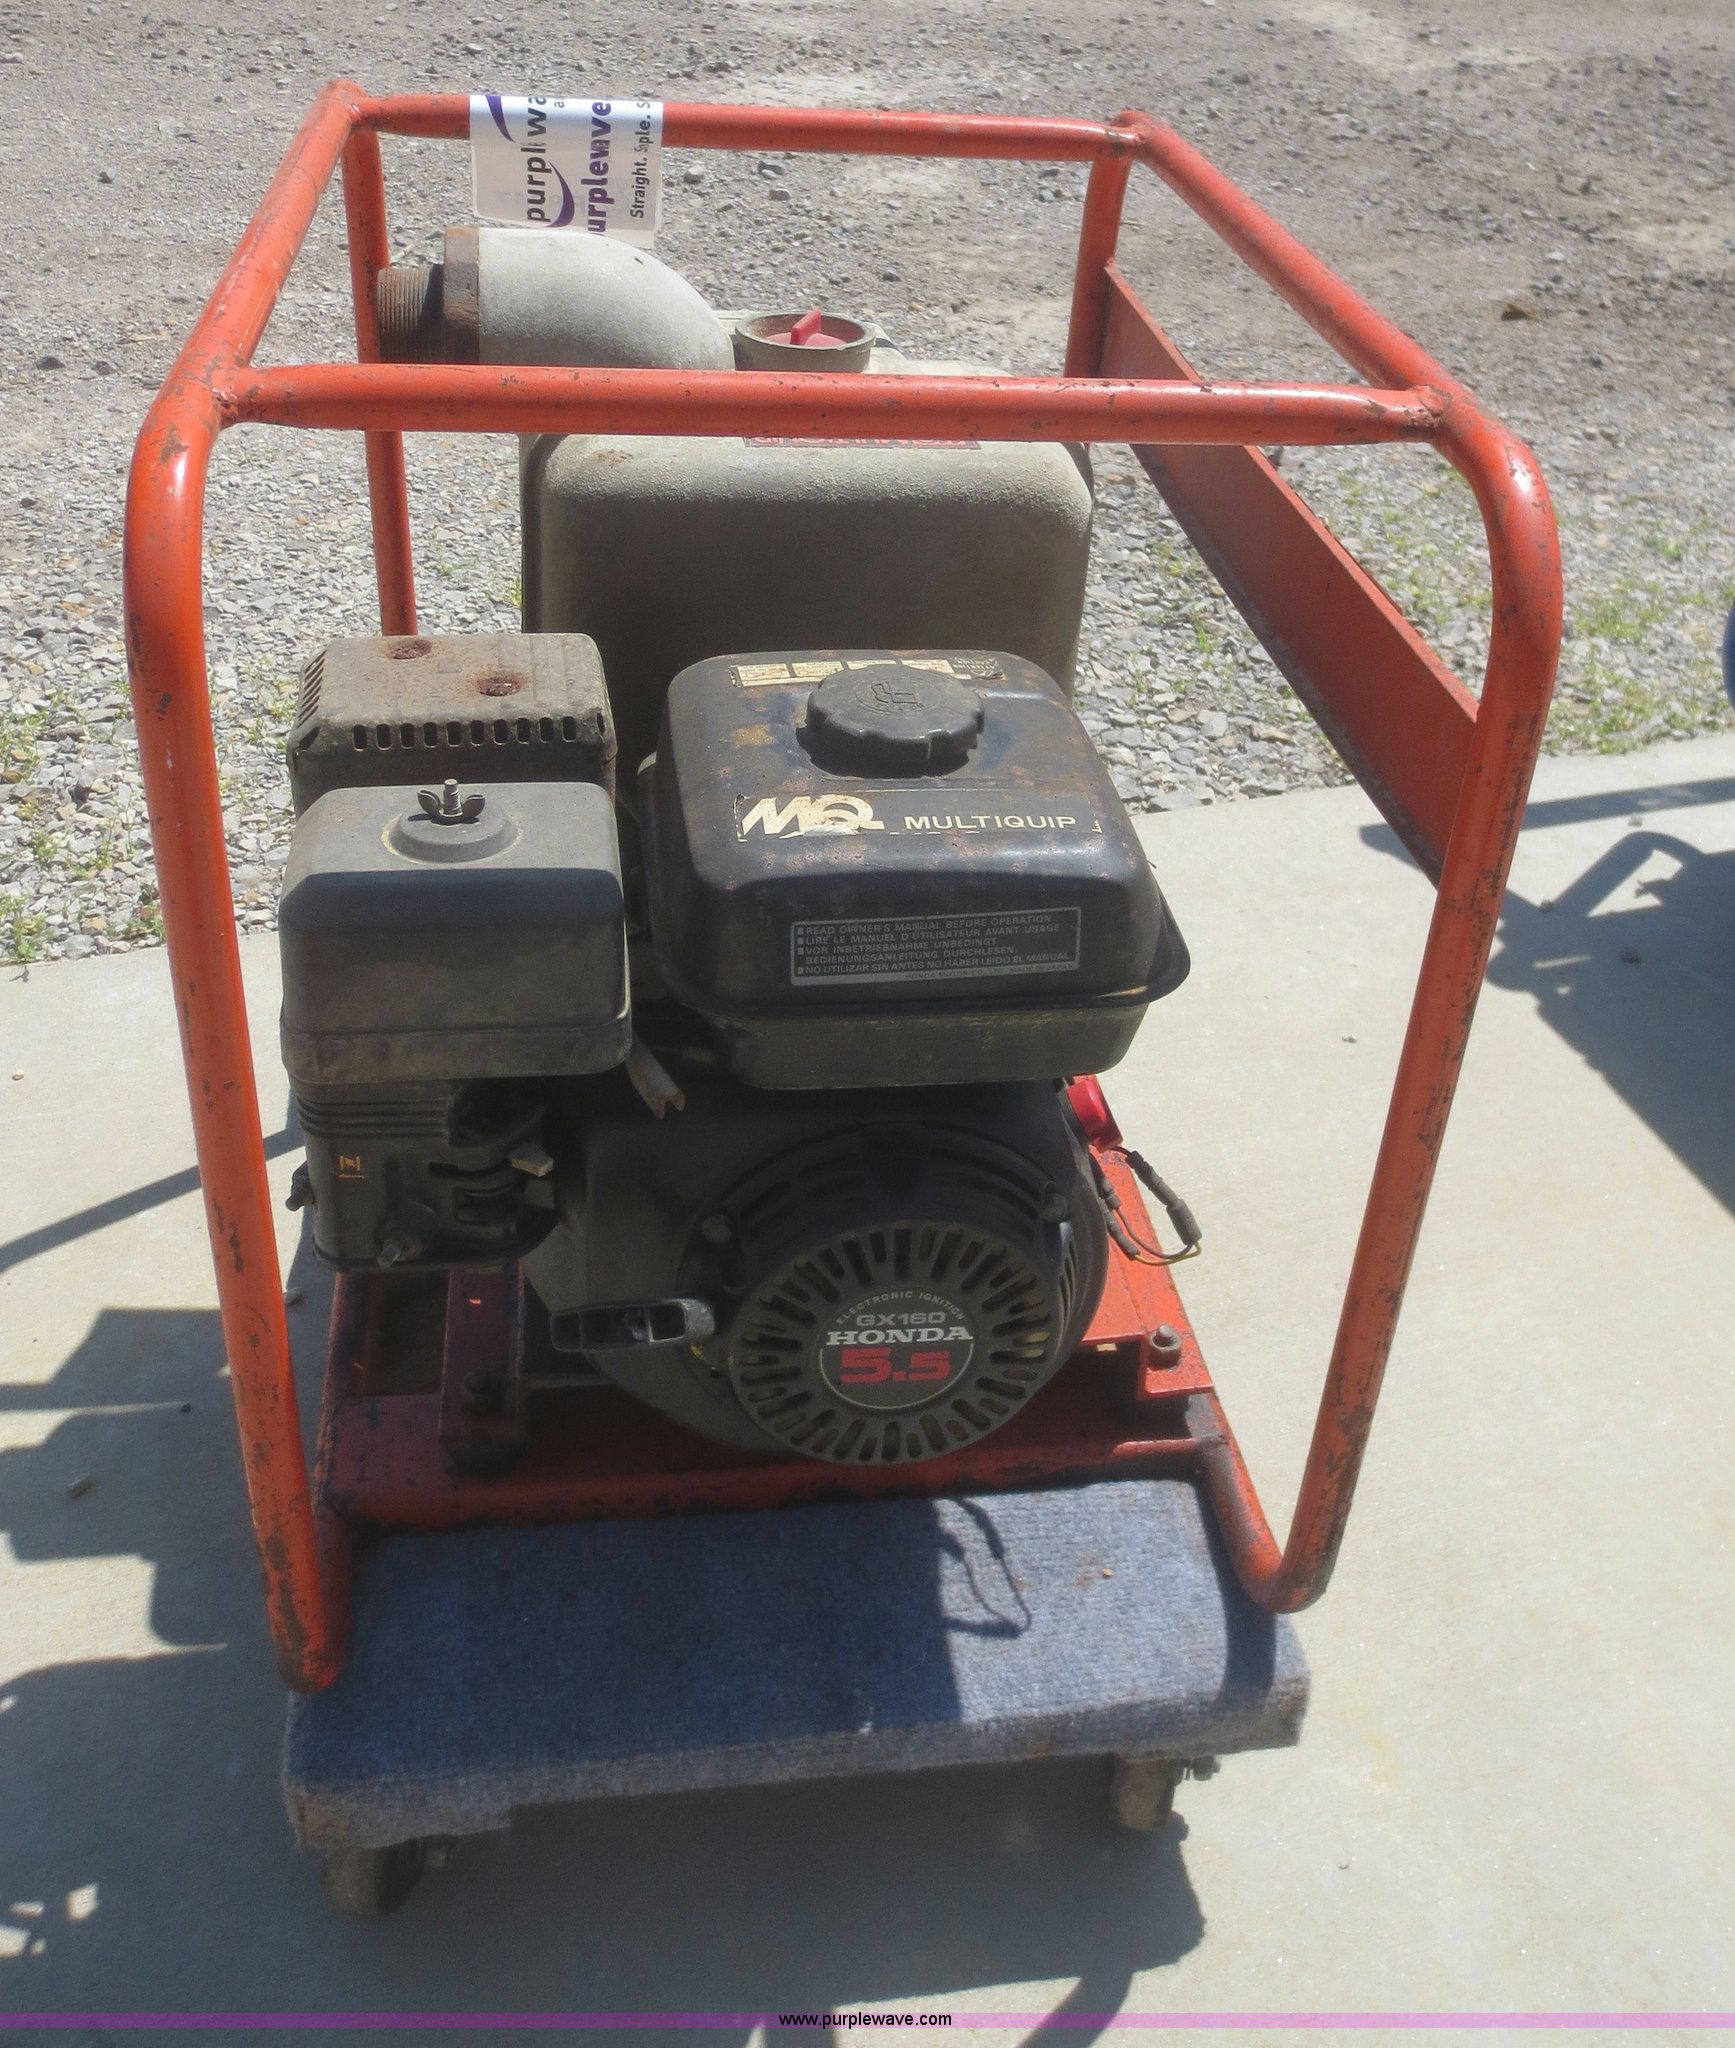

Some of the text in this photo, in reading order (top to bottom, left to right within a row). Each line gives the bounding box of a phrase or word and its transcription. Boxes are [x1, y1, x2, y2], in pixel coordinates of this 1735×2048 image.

[630, 157, 650, 219] Straight.
[742, 794, 1077, 836] MQ MULTIQUIP
[806, 914, 1052, 936] READ OWNER'S MANUAL BEFORE OPERATION
[806, 923, 1060, 945] LIRE LE MANUEL D'UTILISATEUR AVANT USAGE
[806, 937, 998, 955] VOR INBETRIEBNAHME UNBEDINGT
[805, 965, 820, 974] NO
[823, 963, 870, 974] UTILIZAR
[871, 963, 889, 973] SIN
[891, 961, 925, 971] ANTES
[926, 960, 942, 969] NO
[944, 957, 980, 968] HABER
[981, 955, 1011, 966] LEIDO
[1012, 955, 1025, 964] EL
[806, 950, 938, 965] BEDIENUNGSANLEITUNG
[836, 1290, 966, 1324] ELECTRONIC IGNITION
[856, 1311, 947, 1326] GX160
[826, 1326, 974, 1346] HONDA
[840, 1347, 952, 1384] 5.5
